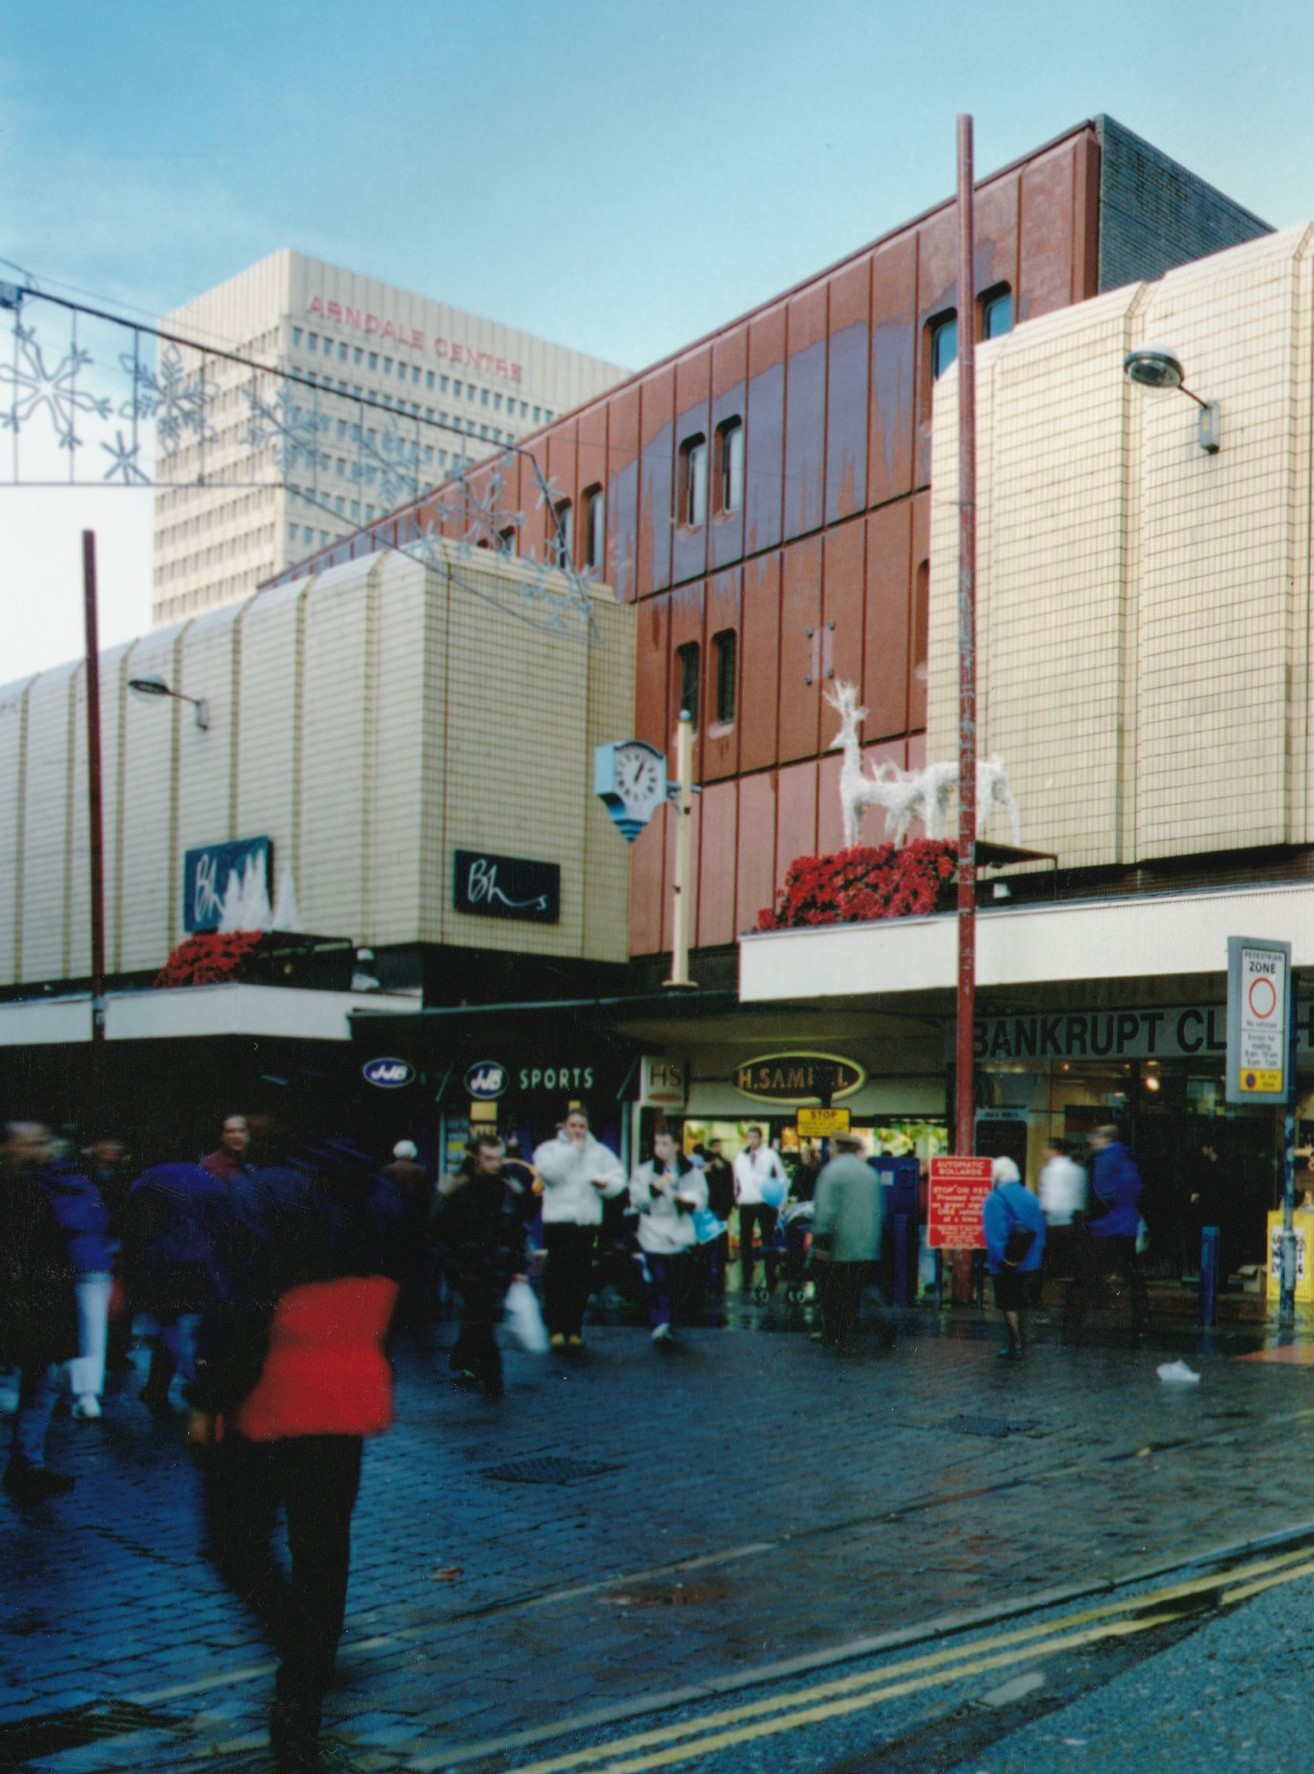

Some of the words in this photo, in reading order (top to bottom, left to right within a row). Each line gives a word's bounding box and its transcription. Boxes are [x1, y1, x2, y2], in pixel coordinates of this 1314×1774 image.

[307, 296, 425, 351] ARNDALE
[433, 336, 524, 385] CENTRE
[467, 858, 548, 911] Bhs
[1244, 951, 1283, 961] PEDESTRIAN
[1249, 961, 1277, 974] ZONE
[974, 1012, 1165, 1059] BANKRUPT
[370, 1065, 408, 1081] JJB
[470, 1068, 503, 1092] JJB
[519, 1067, 594, 1090] SPORTS
[650, 1063, 681, 1088] HS
[811, 1110, 838, 1120] STOP
[937, 1161, 985, 1169] AUTOMATIC
[939, 1168, 983, 1176] BOLLARDS
[932, 1185, 954, 1195] STOP
